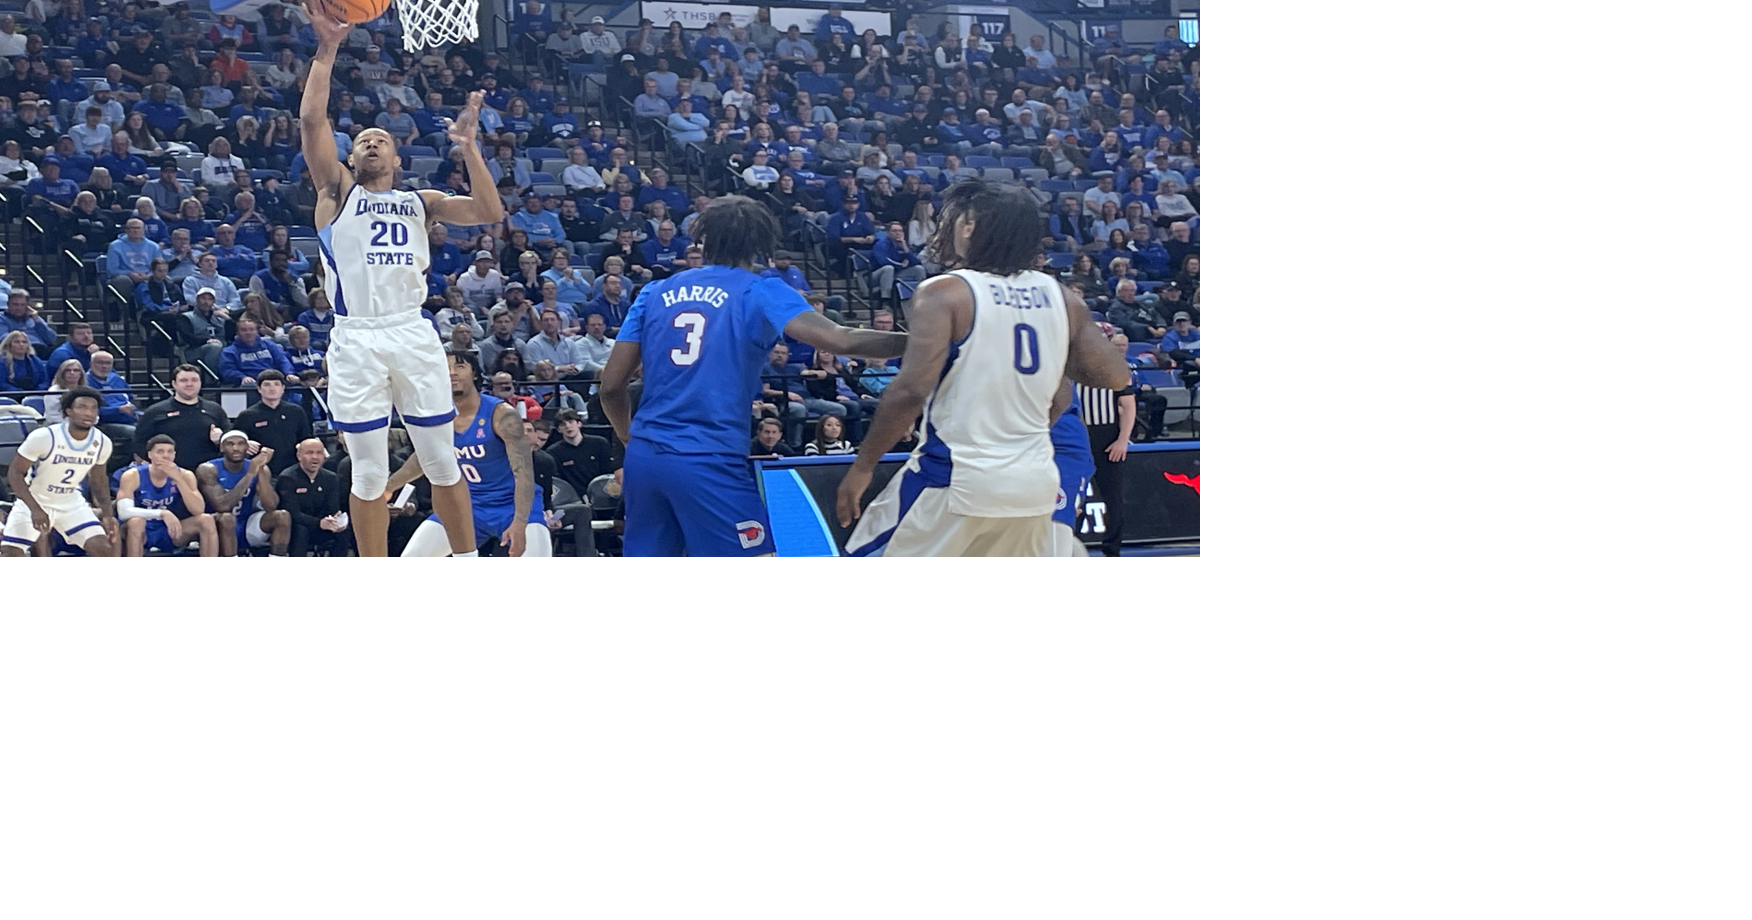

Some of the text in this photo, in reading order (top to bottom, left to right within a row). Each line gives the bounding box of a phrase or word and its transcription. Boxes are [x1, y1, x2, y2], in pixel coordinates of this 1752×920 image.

[519, 3, 546, 15] 17
[681, 11, 716, 20] THSB
[982, 22, 1005, 35] 117
[1092, 26, 1106, 38] 11
[590, 36, 610, 46] ISU
[370, 221, 408, 246] 20
[366, 252, 413, 265] STATE
[661, 285, 729, 308] HARRIS
[670, 312, 706, 366] 3
[1014, 323, 1039, 375] 0
[454, 444, 486, 460] MU
[60, 469, 75, 484] 2
[141, 496, 174, 507] SMU
